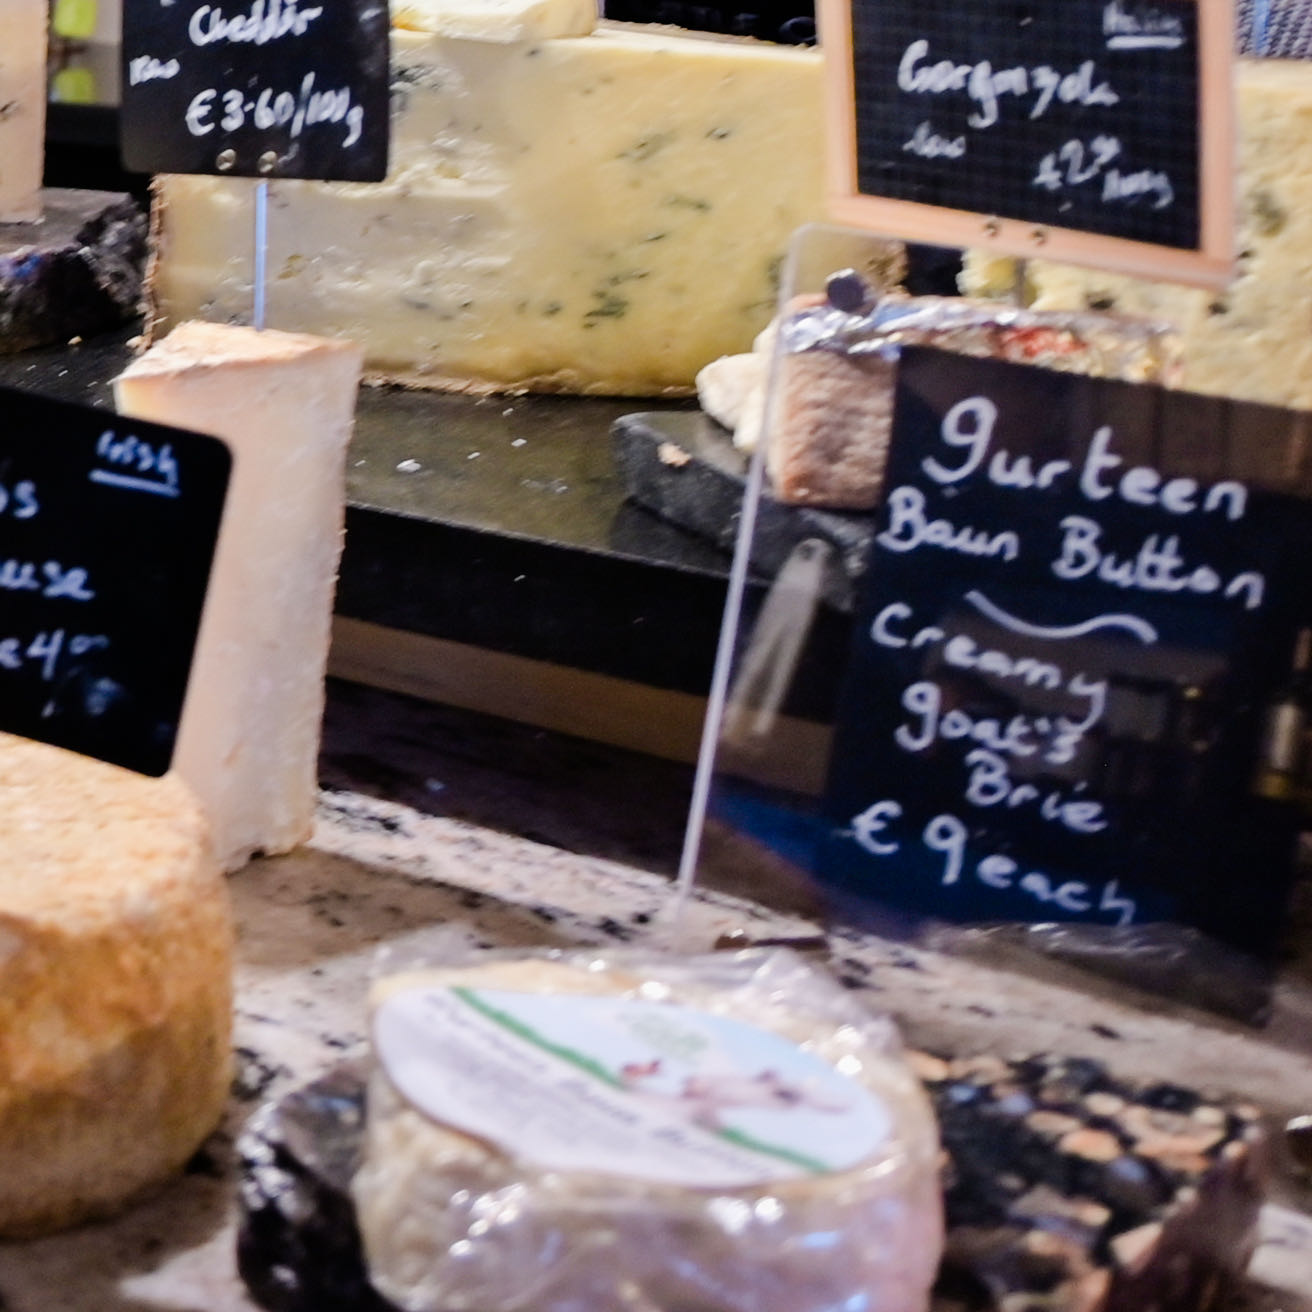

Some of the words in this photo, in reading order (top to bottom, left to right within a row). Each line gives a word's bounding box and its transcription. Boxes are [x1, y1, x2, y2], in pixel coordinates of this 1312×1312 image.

[1051, 517, 1266, 610] Button
[870, 602, 1108, 733] Creamy
[965, 749, 1109, 833] Brie
